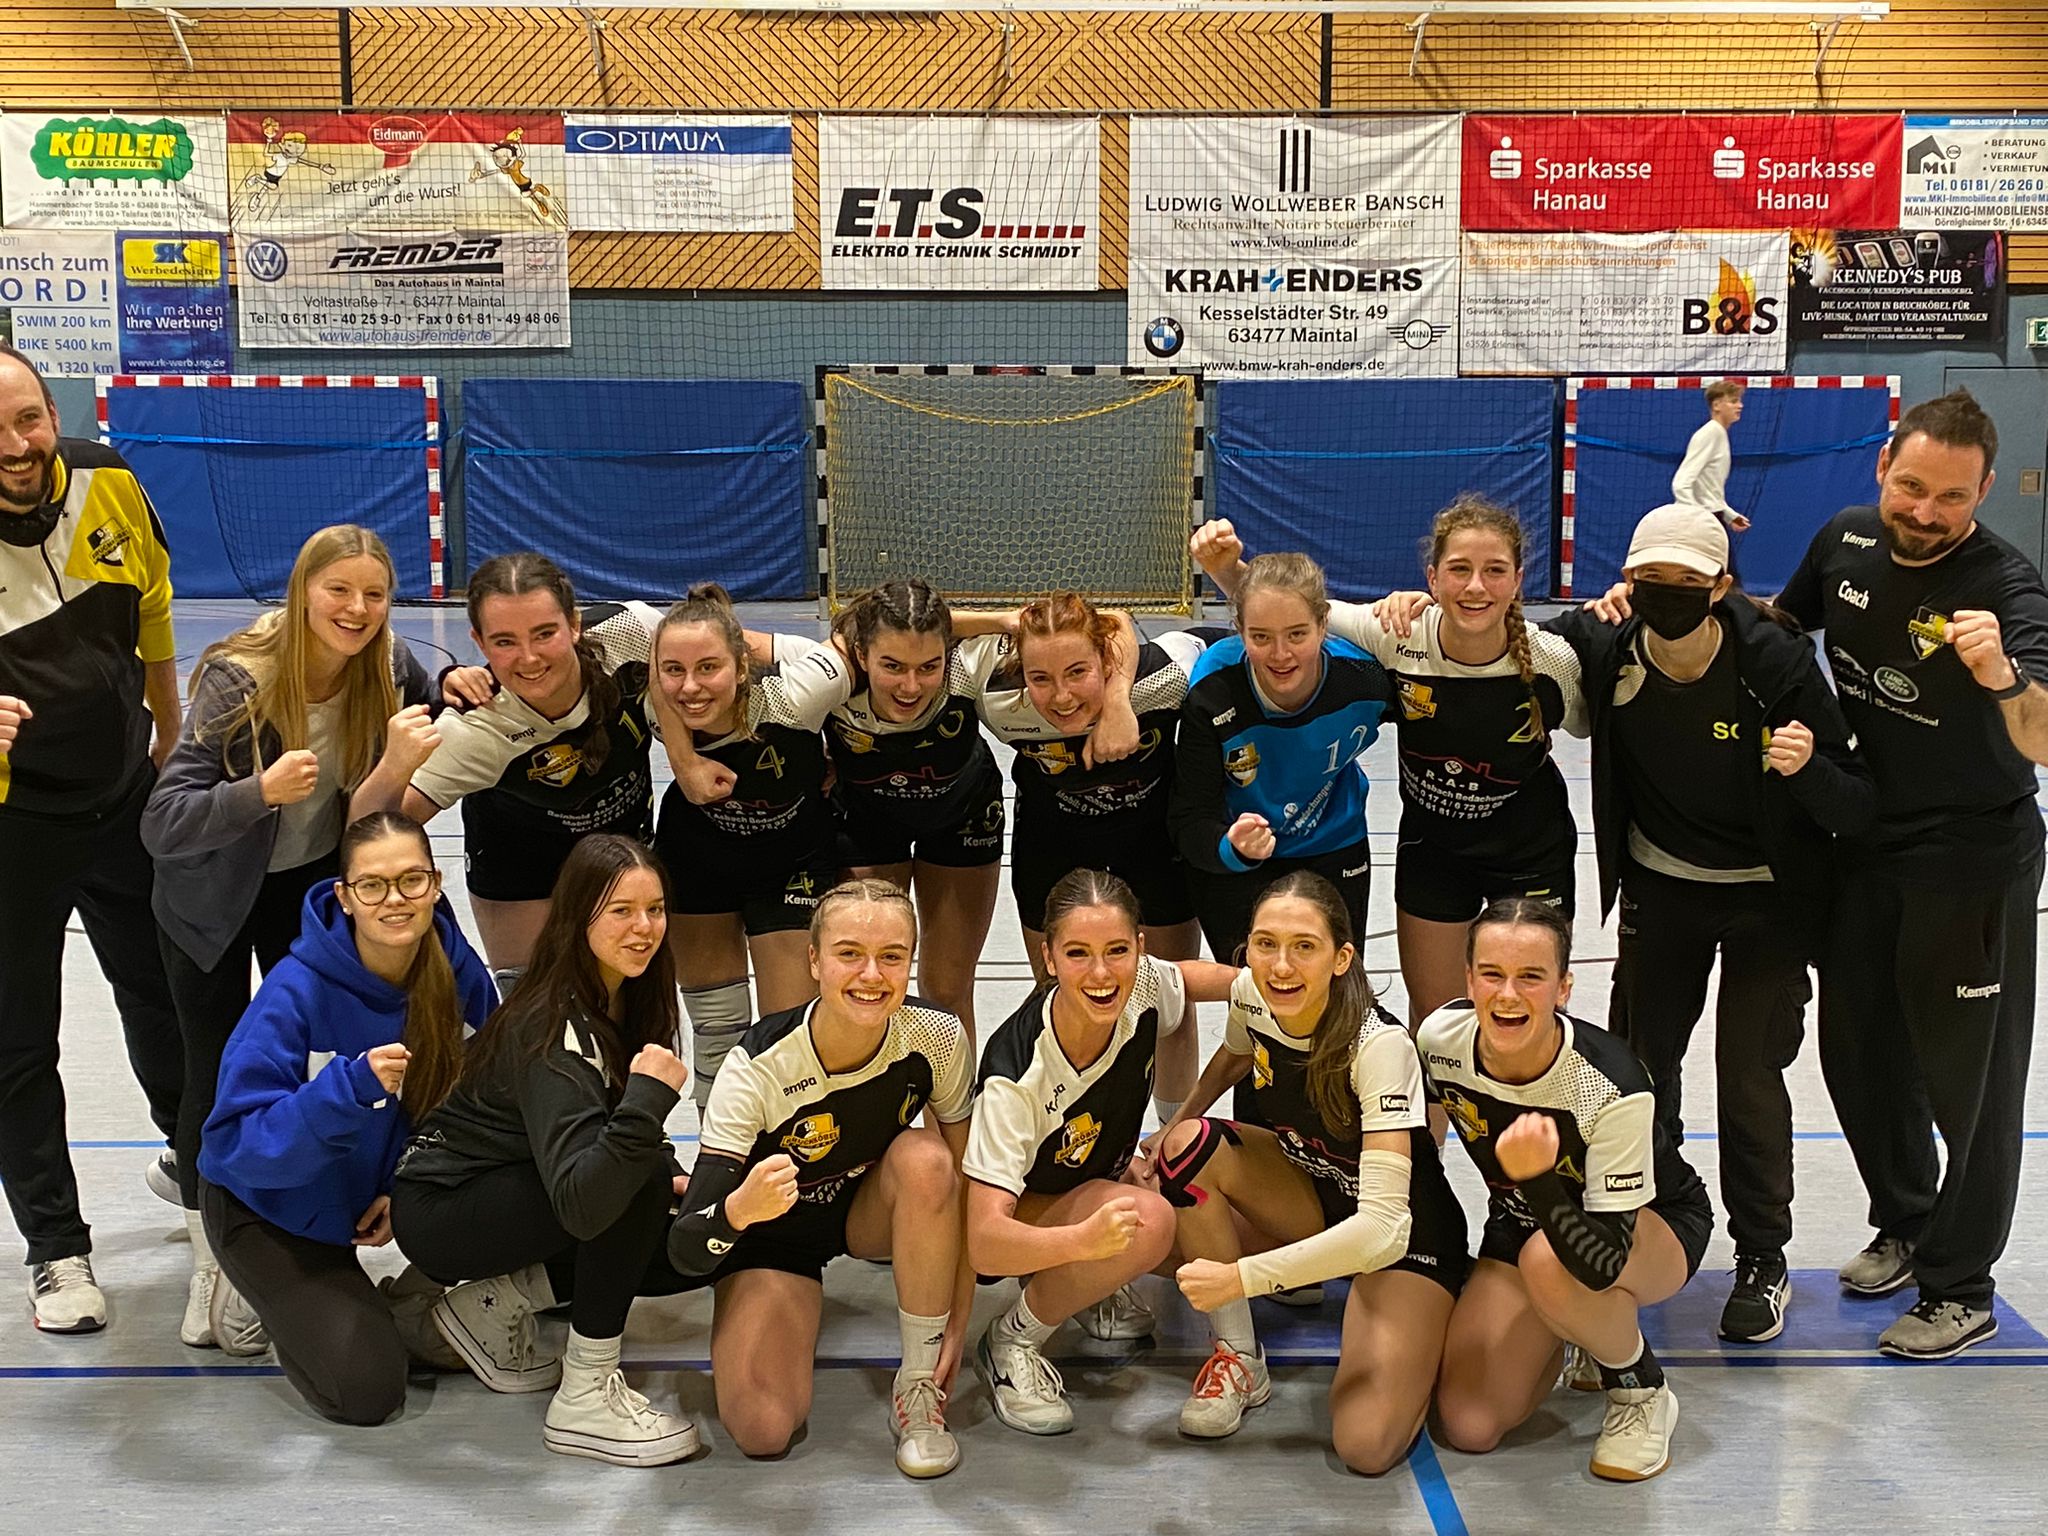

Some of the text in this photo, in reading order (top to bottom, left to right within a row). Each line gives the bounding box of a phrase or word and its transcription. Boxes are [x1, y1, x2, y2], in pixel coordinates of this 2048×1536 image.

[373, 127, 423, 141] Eidmann
[576, 129, 726, 152] OPTIMUM
[49, 127, 177, 159] KÖHLER
[1990, 138, 2046, 147] BERATUNG
[1990, 152, 2039, 160] VERKAUF
[71, 160, 160, 168] BAUMSCHULEN
[1534, 156, 1876, 184] Sparkasse Sparkasse
[328, 174, 401, 195] Jetzt geht's
[1925, 179, 1948, 191] Tel.
[1960, 179, 1973, 191] 61
[1975, 179, 1989, 191] 81
[1999, 179, 2015, 191] 26
[2017, 179, 2033, 191] 26
[72, 189, 90, 197] Ihr
[94, 189, 137, 197] Garten
[368, 184, 461, 208] um die Wurst!
[1532, 188, 1830, 211] Hanau Hanau
[94, 201, 119, 209] Straße
[1145, 194, 1445, 213] LUDWIG WOLLWEBER BANSCH
[1172, 217, 1417, 231] Rechtsanwälte Notare Steuerberater
[1992, 218, 2008, 227] Str.
[1229, 236, 1359, 249] www.lwb-online.de
[328, 238, 503, 269] FREMDER
[831, 244, 1082, 258] ELEKTRO TECHNIK SCHMIDT
[62, 257, 109, 272] zum
[1481, 256, 1528, 268] sonstige
[130, 265, 215, 278] Werbedesign
[1928, 267, 1963, 284] PUB
[374, 279, 505, 288] Das Autohaus in Maintal
[303, 295, 506, 308] Voltastraße 7 63477 Maintal
[1820, 301, 1836, 310] DIE
[1837, 301, 1881, 310] LOCATION
[1893, 300, 1951, 310] BRUCHKÖBEL
[1952, 300, 1970, 310] FÜR
[125, 303, 224, 316] Wir machen
[1199, 304, 1388, 322] Kesselstädter Str. 49
[1682, 296, 1779, 336] B&S
[16, 315, 111, 328] SWIM 200 km
[126, 317, 224, 331] Ihre Werbung!
[292, 313, 308, 325] 61
[312, 313, 328, 325] 81
[340, 313, 357, 325] 40
[360, 313, 377, 325] 25
[417, 312, 442, 325] Fax
[457, 313, 472, 325] 61
[476, 313, 492, 325] 81
[505, 313, 521, 325] 49
[525, 313, 541, 325] 48
[543, 313, 560, 325] 06
[1855, 312, 1880, 322] DART
[1881, 312, 1899, 322] UND
[1900, 312, 1989, 322] VERANSTALTUNGEN
[1148, 317, 1181, 332] BMW
[318, 329, 492, 342] www.autohaus-fremder.de
[1228, 327, 1358, 343] 63477 Maintal
[1407, 330, 1430, 340] MINI
[18, 338, 112, 351] BIKE 5400 km
[58, 361, 114, 374] 1320 km
[1201, 359, 1385, 372] www.bmw-krah-enders.de
[1841, 530, 1877, 549] Kempa
[1837, 578, 1870, 610] Coach
[1883, 671, 1904, 686] LAND
[1884, 679, 1910, 696] ROVER
[1321, 724, 1368, 775] 12
[755, 744, 786, 780] 4
[1420, 779, 1454, 799] Asbach
[963, 835, 998, 848] Kempa
[783, 893, 820, 909] Kemp
[1956, 983, 2001, 1000] Kempa
[1422, 1050, 1462, 1070] Kempa
[782, 1076, 818, 1097] empa
[1606, 1175, 1643, 1190] Kempa
